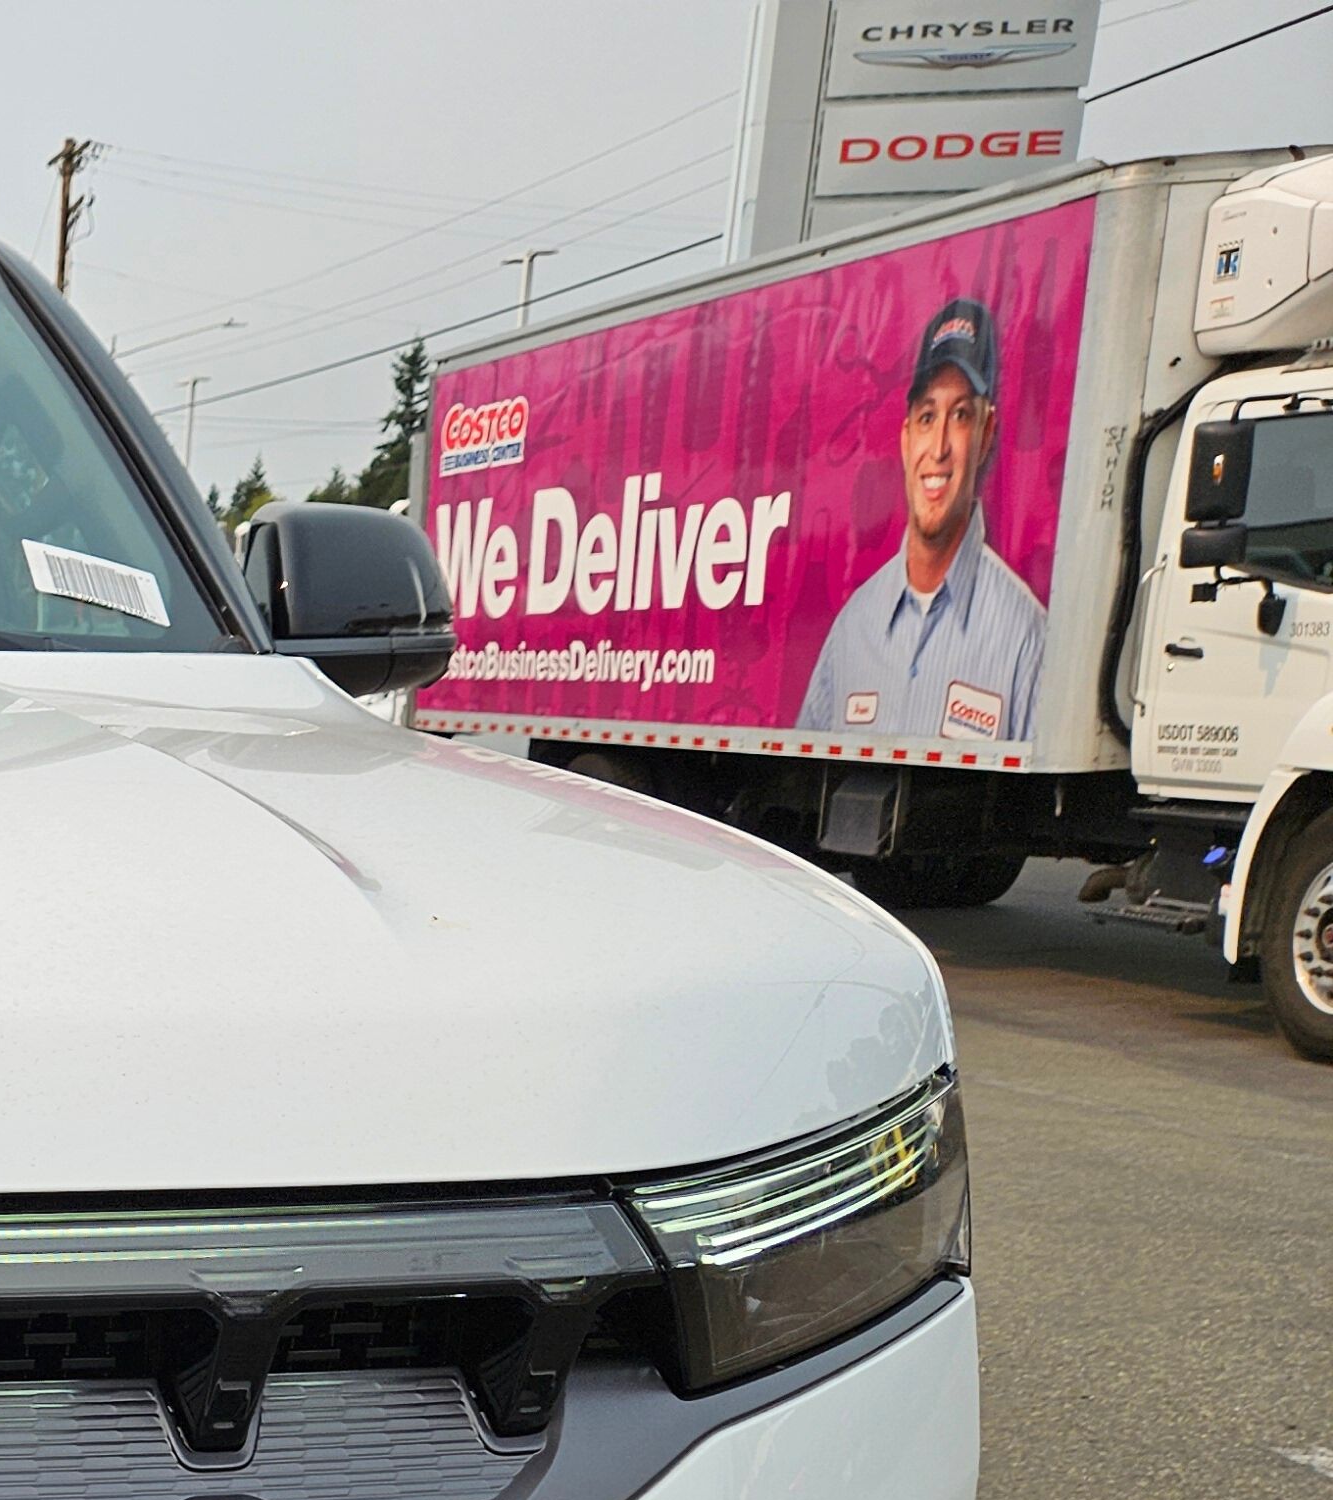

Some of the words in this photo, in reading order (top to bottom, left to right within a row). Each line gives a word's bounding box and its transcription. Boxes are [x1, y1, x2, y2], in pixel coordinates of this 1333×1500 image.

[862, 18, 1074, 42] CHRYSLER
[839, 130, 1064, 164] DODGE
[445, 402, 525, 450] COSTCO
[436, 498, 518, 619] We
[526, 472, 791, 616] Deliver
[441, 640, 715, 692] stcoBusinessDelivery.com
[1157, 724, 1195, 741] USDOT
